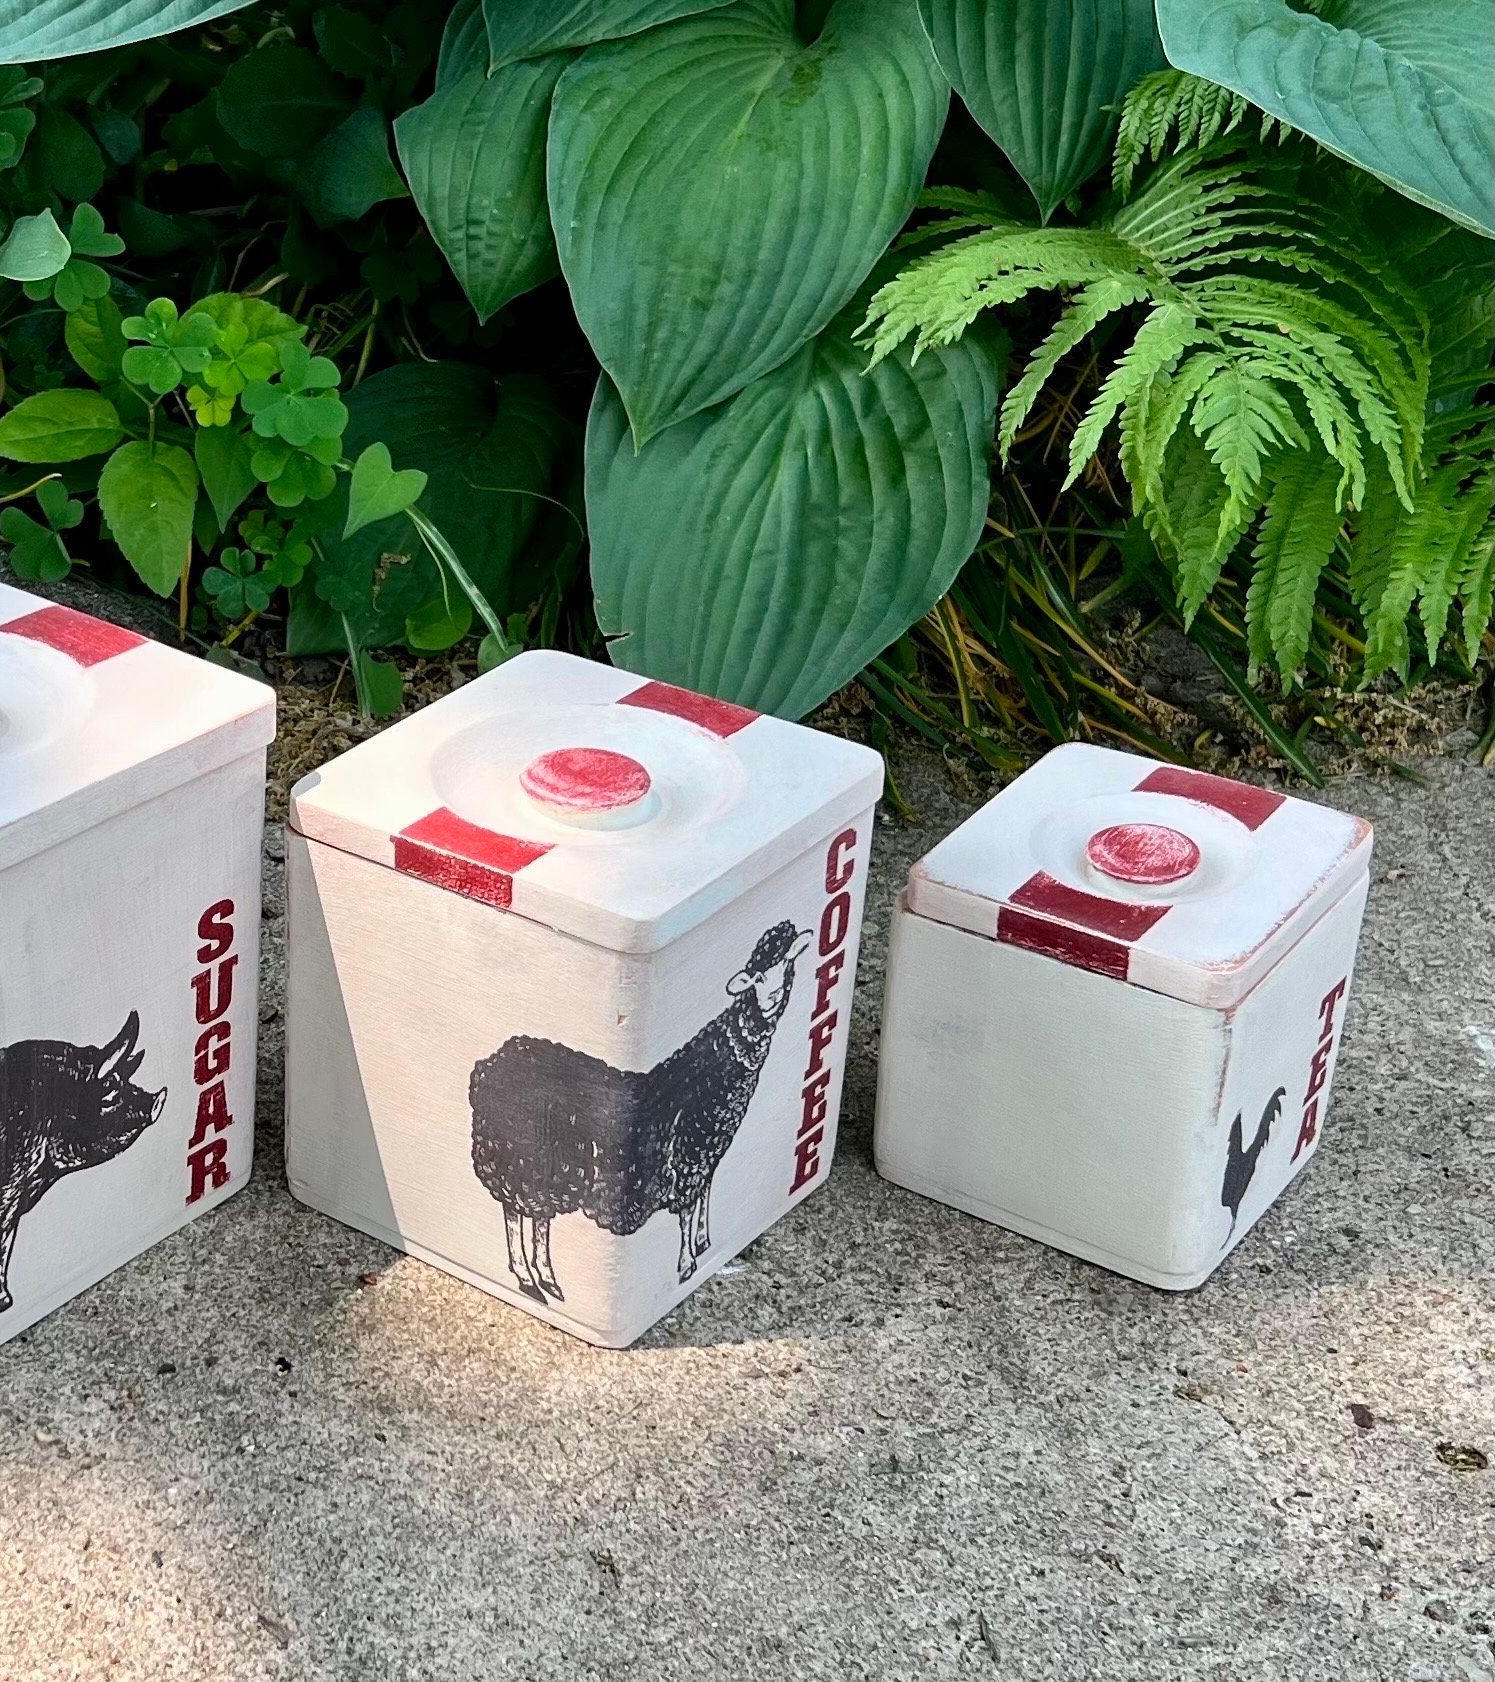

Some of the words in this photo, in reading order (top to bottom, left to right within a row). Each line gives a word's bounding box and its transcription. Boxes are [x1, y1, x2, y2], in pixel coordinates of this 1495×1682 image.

[185, 898, 238, 1207] SUGAR
[788, 828, 857, 1196] COFFEE
[1290, 975, 1347, 1165] TEA
